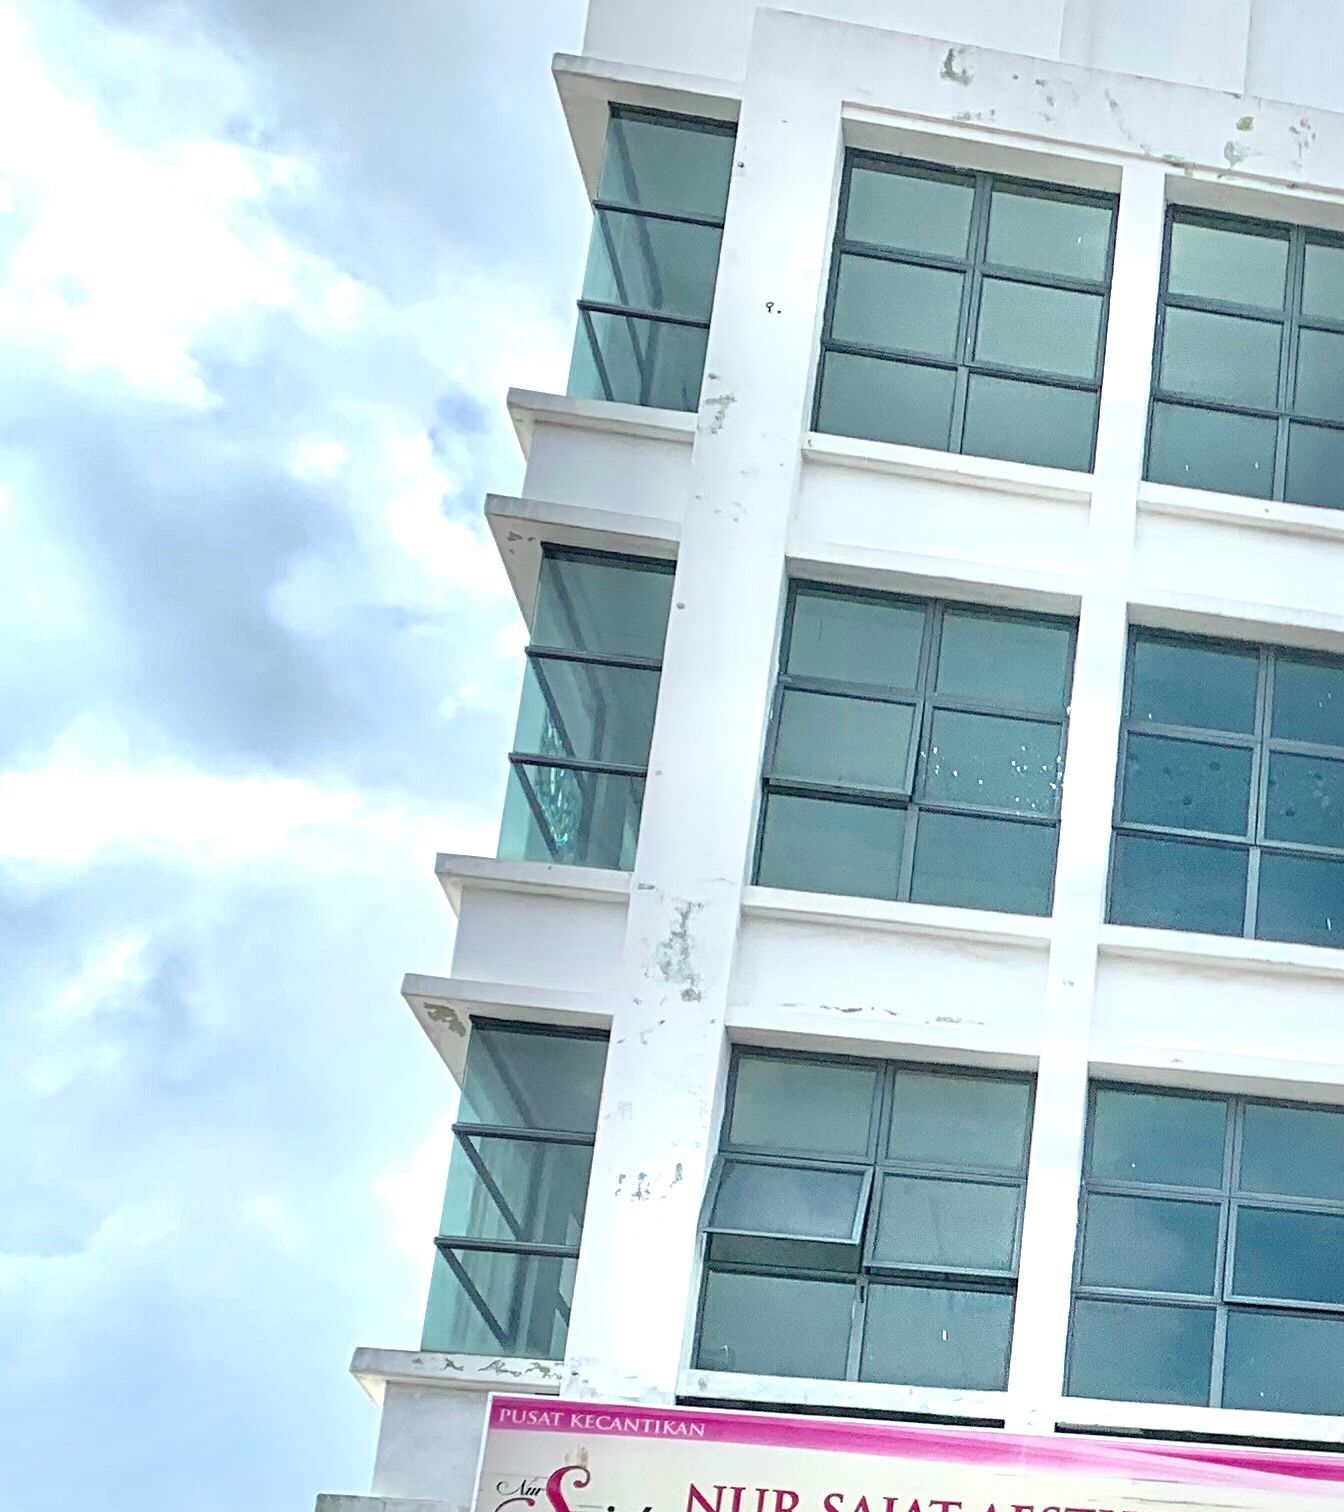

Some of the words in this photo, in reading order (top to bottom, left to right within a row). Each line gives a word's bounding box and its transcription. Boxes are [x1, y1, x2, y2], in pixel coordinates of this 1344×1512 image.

[500, 1408, 564, 1426] PUSAT
[570, 1413, 705, 1437] KECANTIKAN
[496, 1478, 543, 1497] Nur
